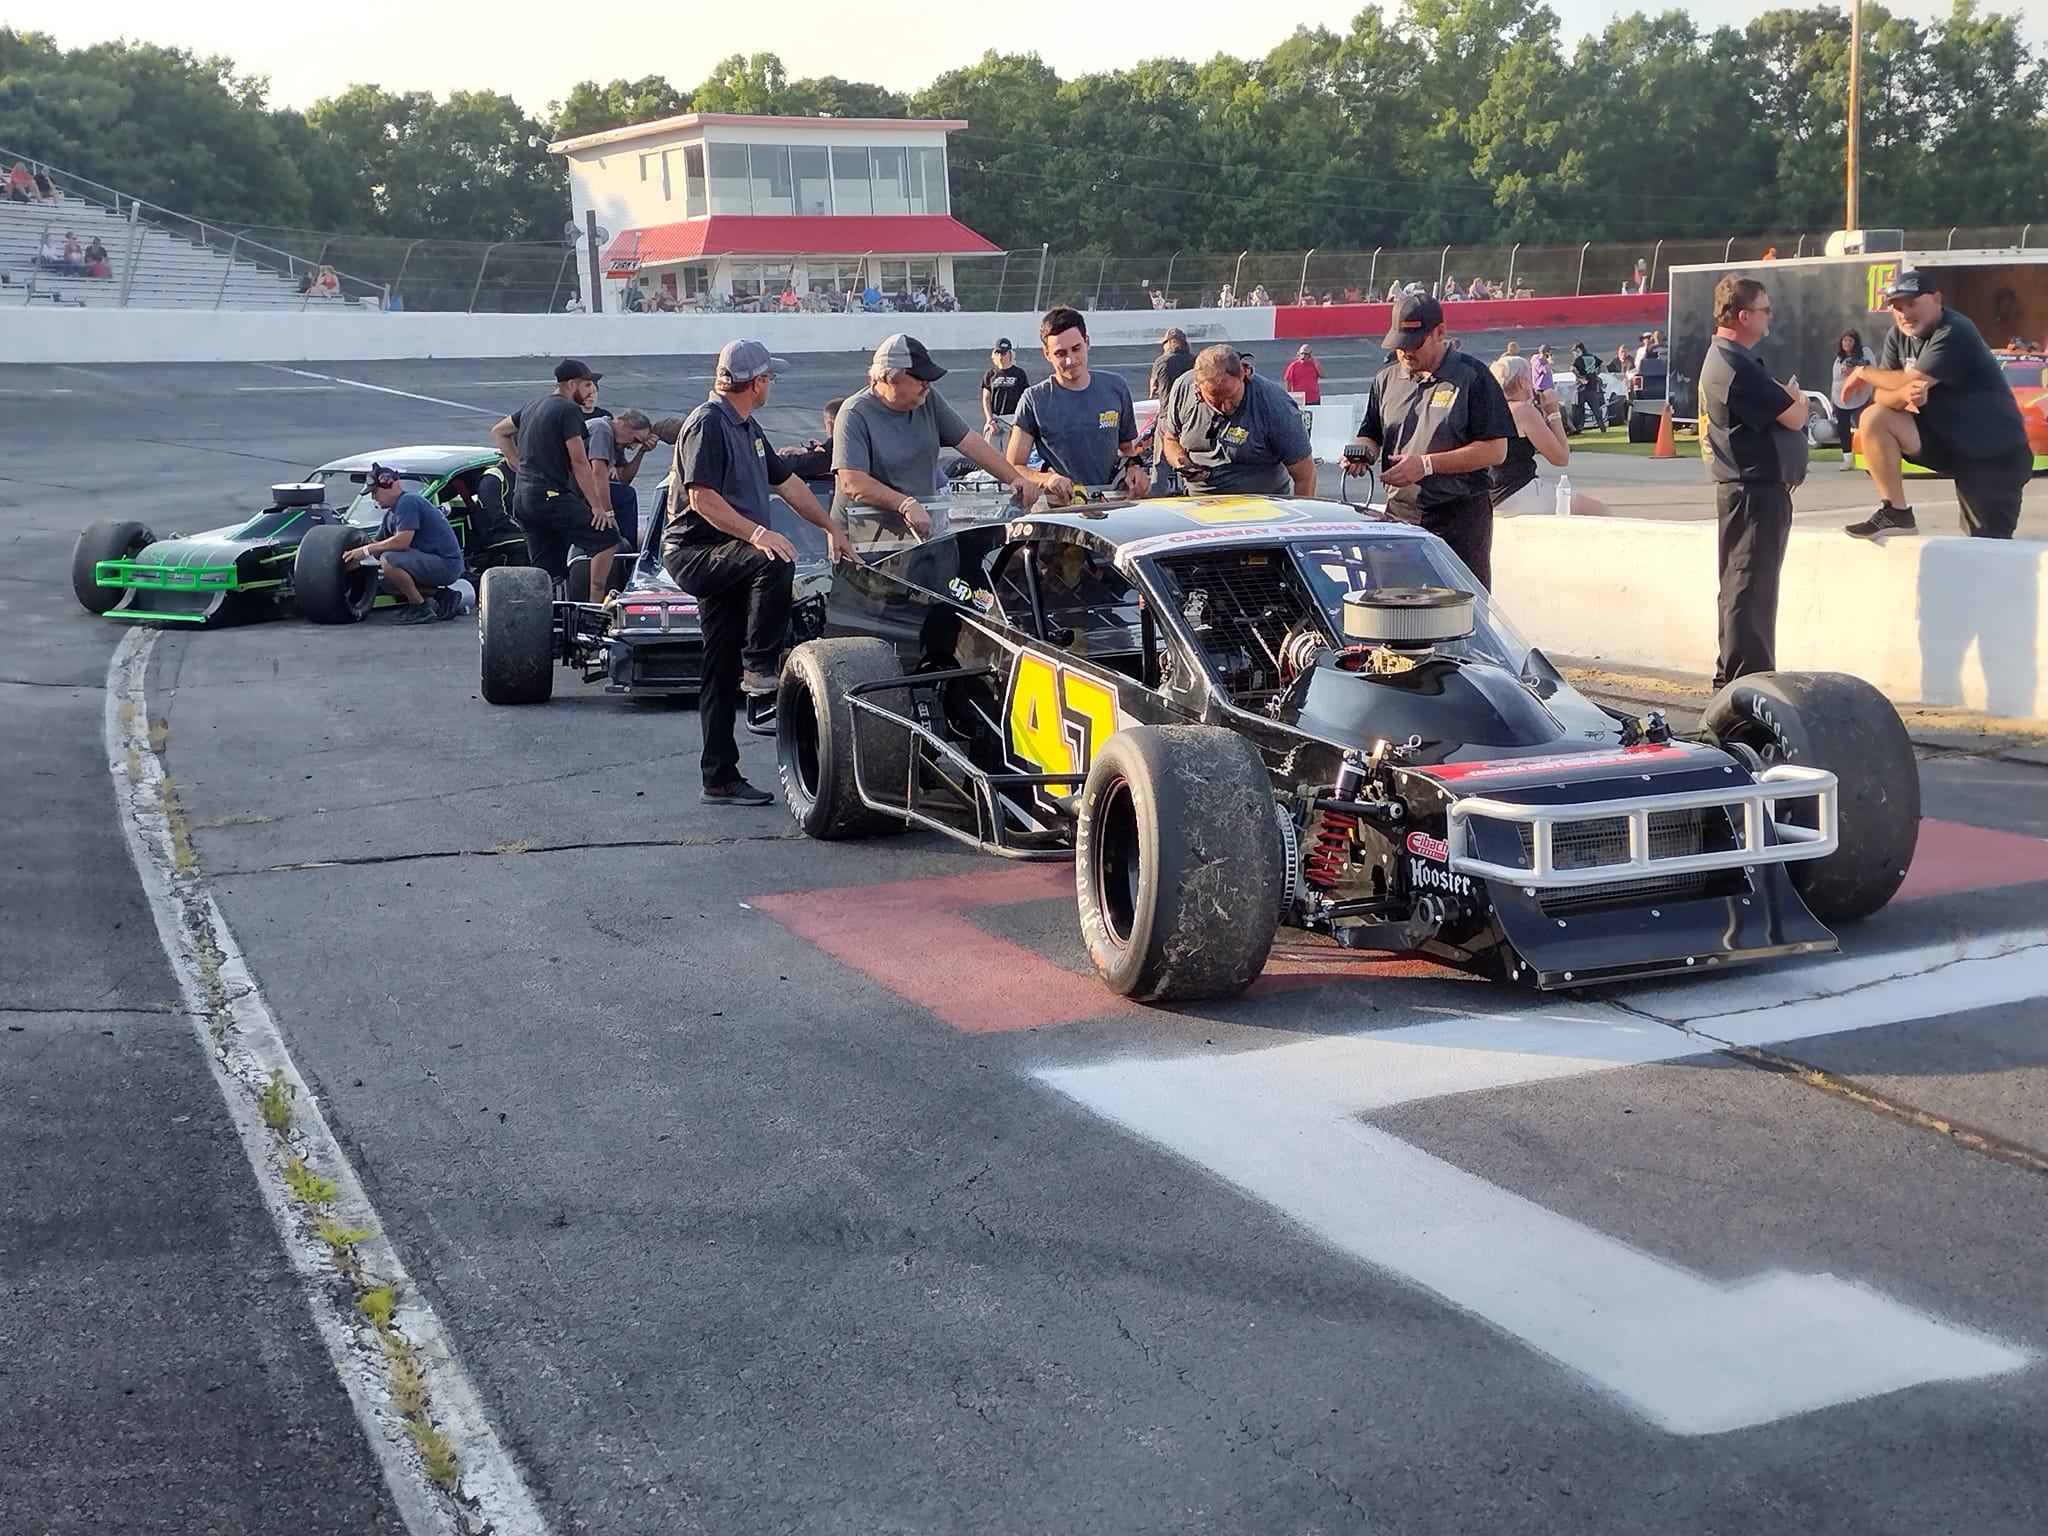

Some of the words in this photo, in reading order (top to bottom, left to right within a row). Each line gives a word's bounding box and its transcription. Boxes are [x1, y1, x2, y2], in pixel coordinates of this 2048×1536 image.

[1168, 525, 1270, 543] CARAWAY
[1277, 524, 1361, 534] STRONG
[1004, 647, 1119, 805] 47
[1410, 857, 1471, 896] Hoosier
